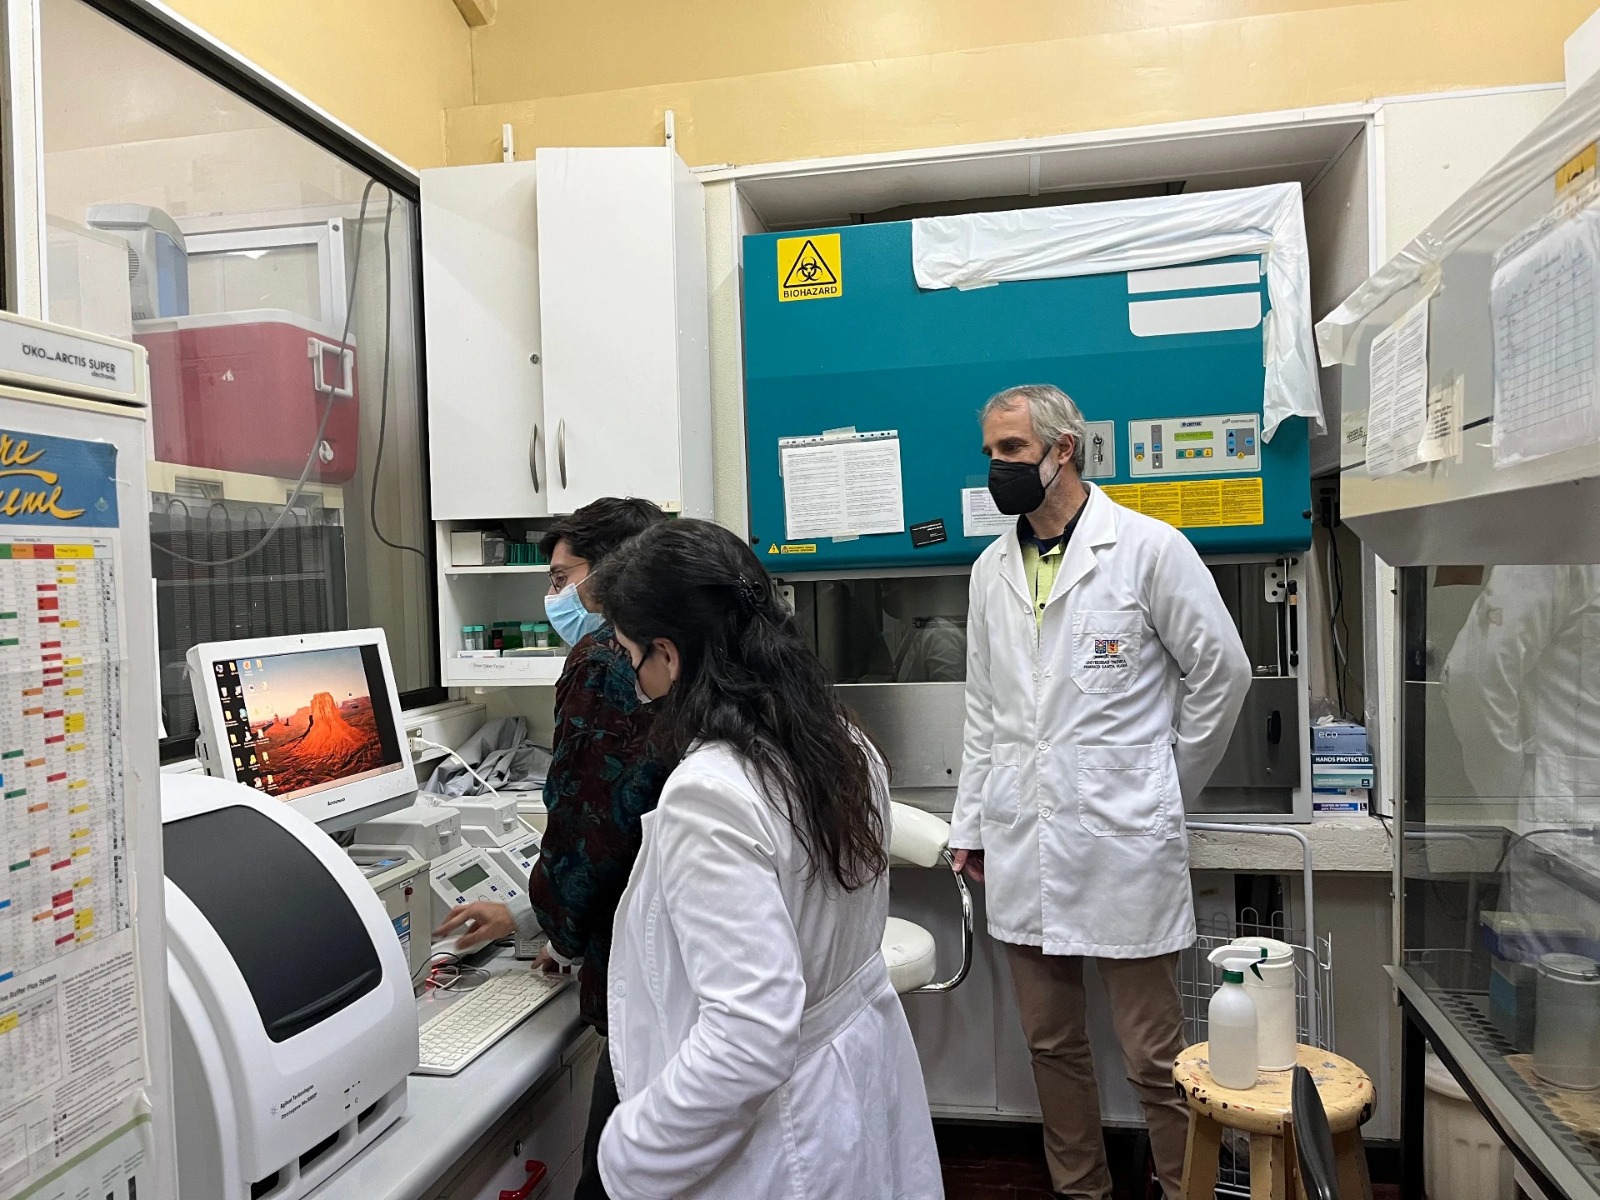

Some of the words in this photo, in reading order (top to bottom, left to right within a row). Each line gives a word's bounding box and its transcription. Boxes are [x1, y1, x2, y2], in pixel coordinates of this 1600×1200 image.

[783, 286, 838, 298] BIOHAZARD
[89, 359, 116, 373] SUPER
[1318, 731, 1338, 739] eco
[39, 974, 57, 986] System
